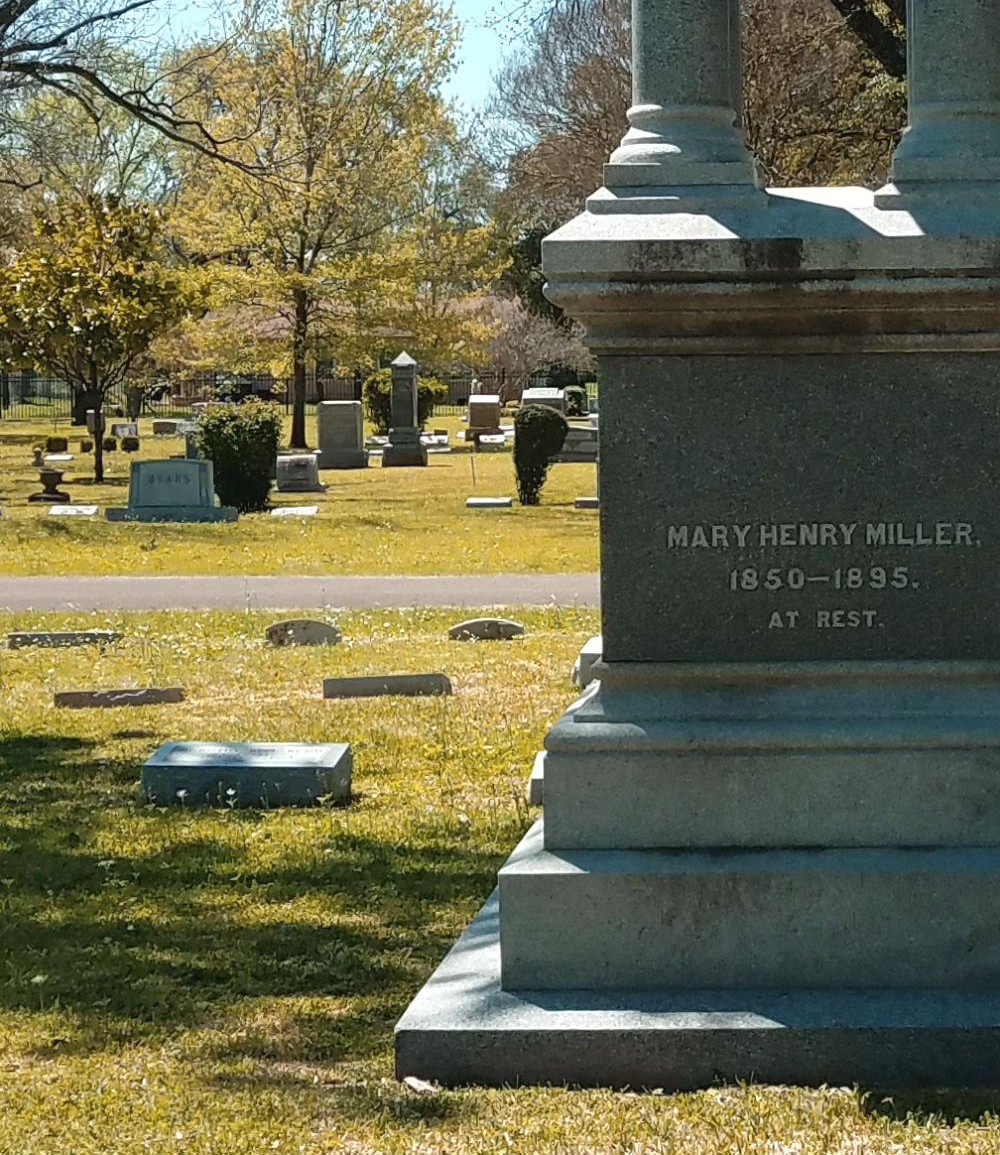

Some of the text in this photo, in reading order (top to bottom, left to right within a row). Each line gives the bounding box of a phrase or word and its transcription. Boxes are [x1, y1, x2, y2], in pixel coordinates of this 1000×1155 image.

[667, 522, 981, 548] MARY HENRY MILLER.
[768, 609, 885, 629] AT REST.
